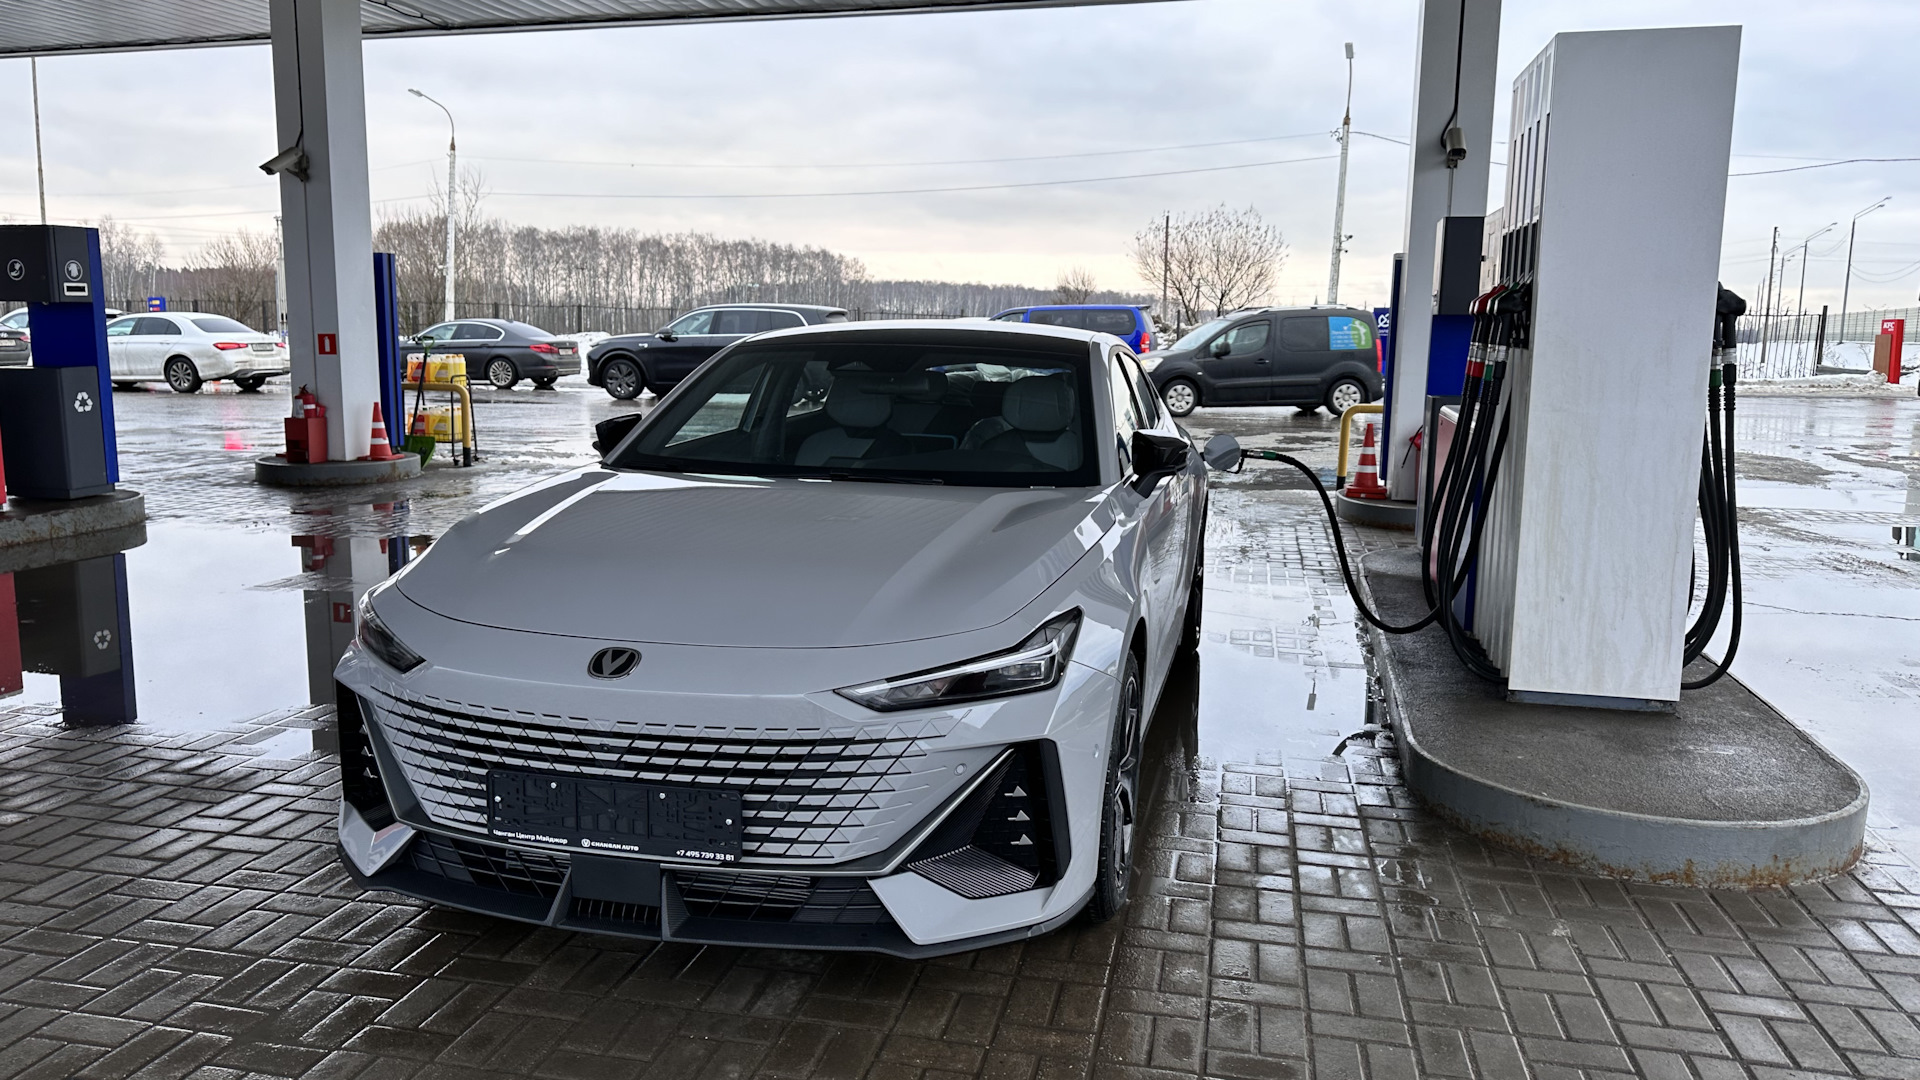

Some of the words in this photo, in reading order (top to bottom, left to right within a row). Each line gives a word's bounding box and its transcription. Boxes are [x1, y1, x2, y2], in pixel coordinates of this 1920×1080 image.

[516, 831, 535, 841] Центр
[622, 844, 639, 852] AUTO
[700, 852, 714, 860] 739
[715, 853, 725, 861] 33
[725, 854, 735, 862] 81
